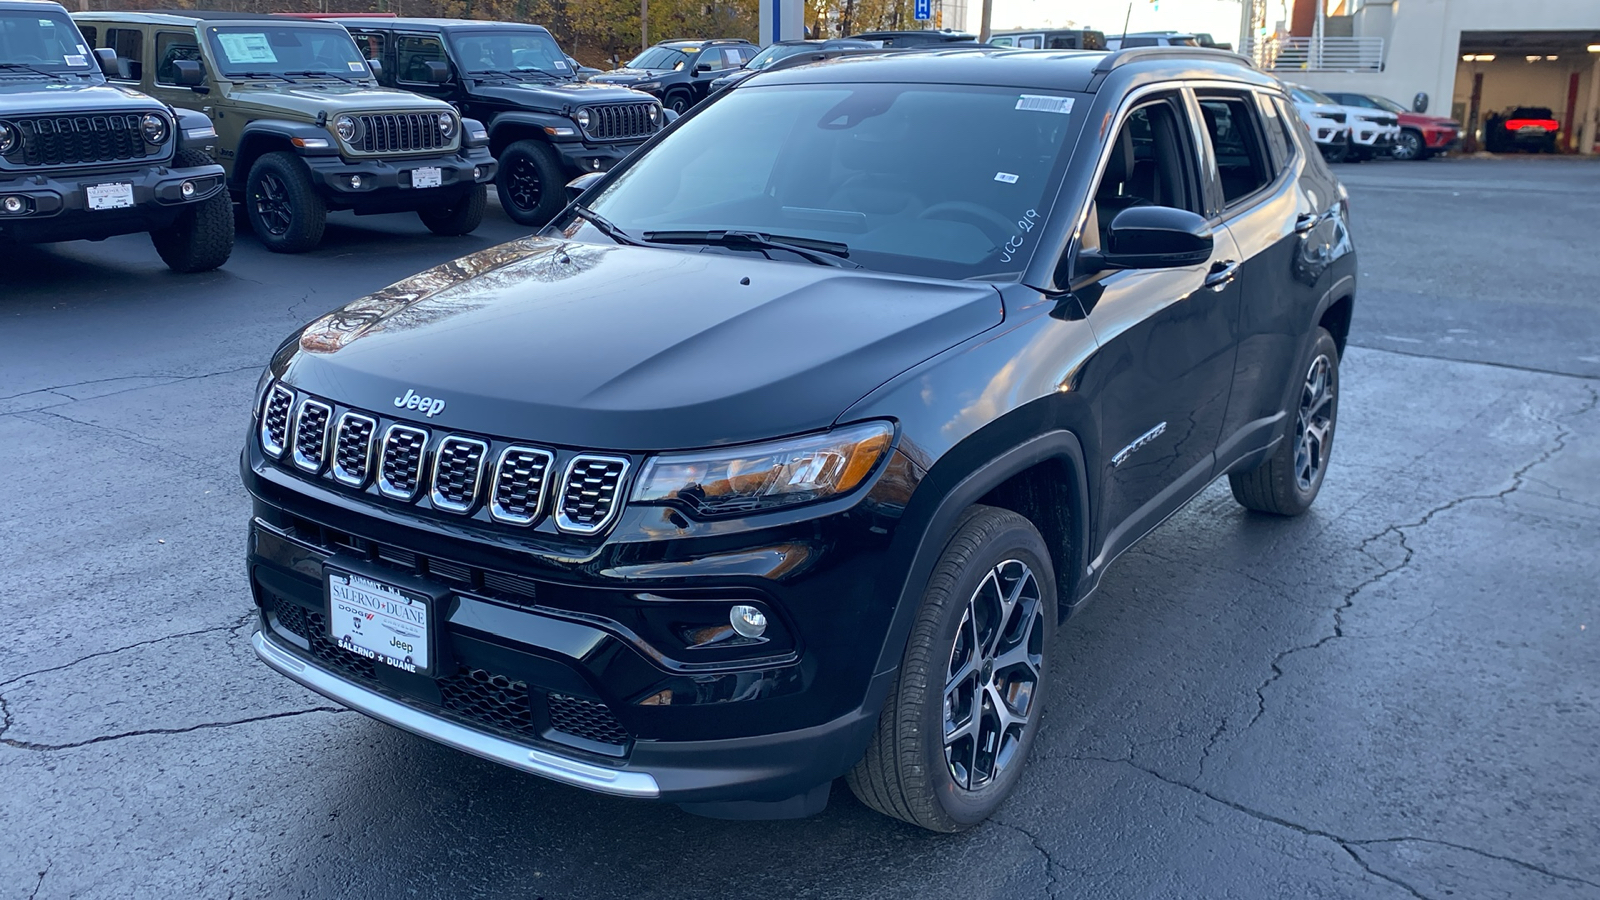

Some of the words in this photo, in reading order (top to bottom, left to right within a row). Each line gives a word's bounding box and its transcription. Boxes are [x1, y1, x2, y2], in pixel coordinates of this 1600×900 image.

[918, 0, 928, 12] H
[1018, 208, 1041, 233] 219
[393, 388, 446, 418] Jeep
[333, 585, 381, 610] SALERNO
[386, 601, 425, 625] DUANE
[338, 603, 368, 618] DODGE
[337, 639, 375, 659] SALERNO
[386, 656, 416, 674] DUANE
[389, 636, 414, 654] Jeep
